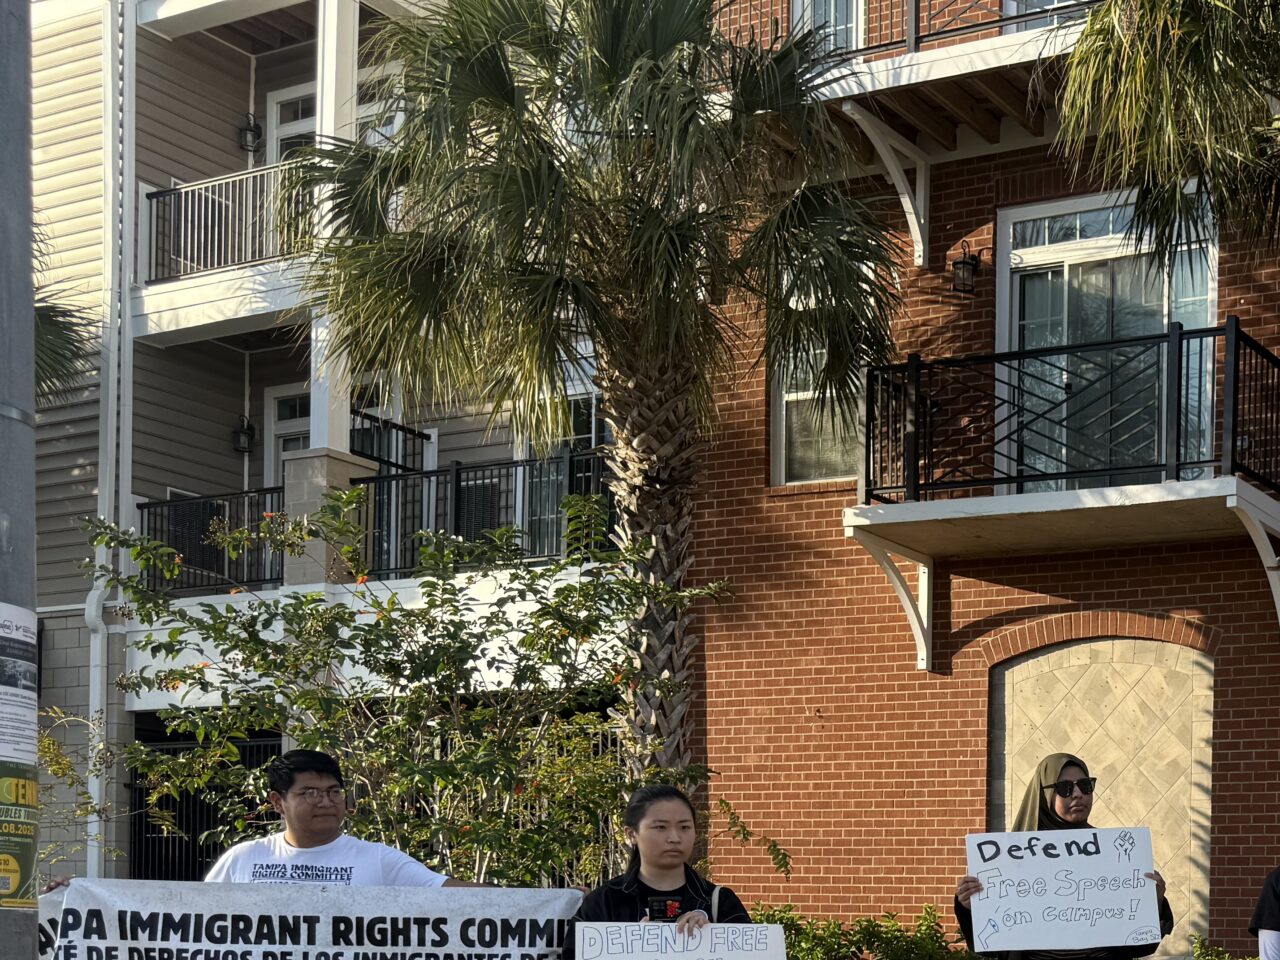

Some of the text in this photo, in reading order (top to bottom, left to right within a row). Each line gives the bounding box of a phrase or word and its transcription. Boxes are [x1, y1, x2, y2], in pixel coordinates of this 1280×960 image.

[976, 832, 1101, 863] Defend
[252, 870, 352, 881] RIGHTS COMMITTEE
[253, 863, 355, 875] TAMPA IMMIGRANT
[976, 866, 1147, 902] Free Speech
[118, 910, 320, 946] IMMIGRANT
[332, 916, 450, 948] RIGHTS
[581, 924, 769, 960] DEFEND FREE
